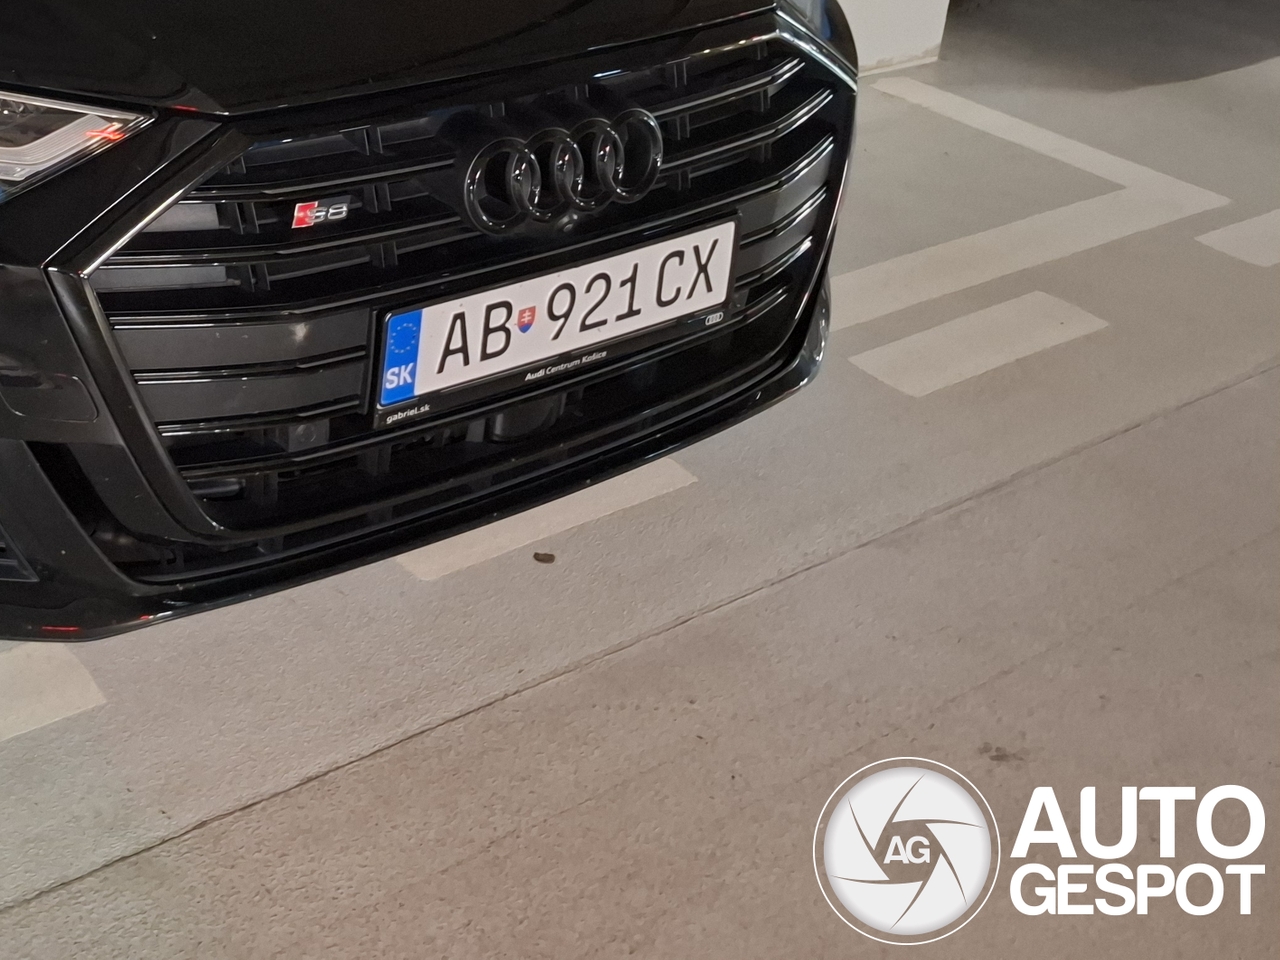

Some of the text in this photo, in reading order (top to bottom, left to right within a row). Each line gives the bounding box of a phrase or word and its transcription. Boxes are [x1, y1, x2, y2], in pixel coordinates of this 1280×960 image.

[303, 202, 348, 224] S8
[385, 362, 415, 389] SK
[436, 300, 514, 374] AB
[524, 368, 546, 381] Audi
[546, 359, 581, 375] Centrum
[386, 403, 431, 425] gabriel.sk
